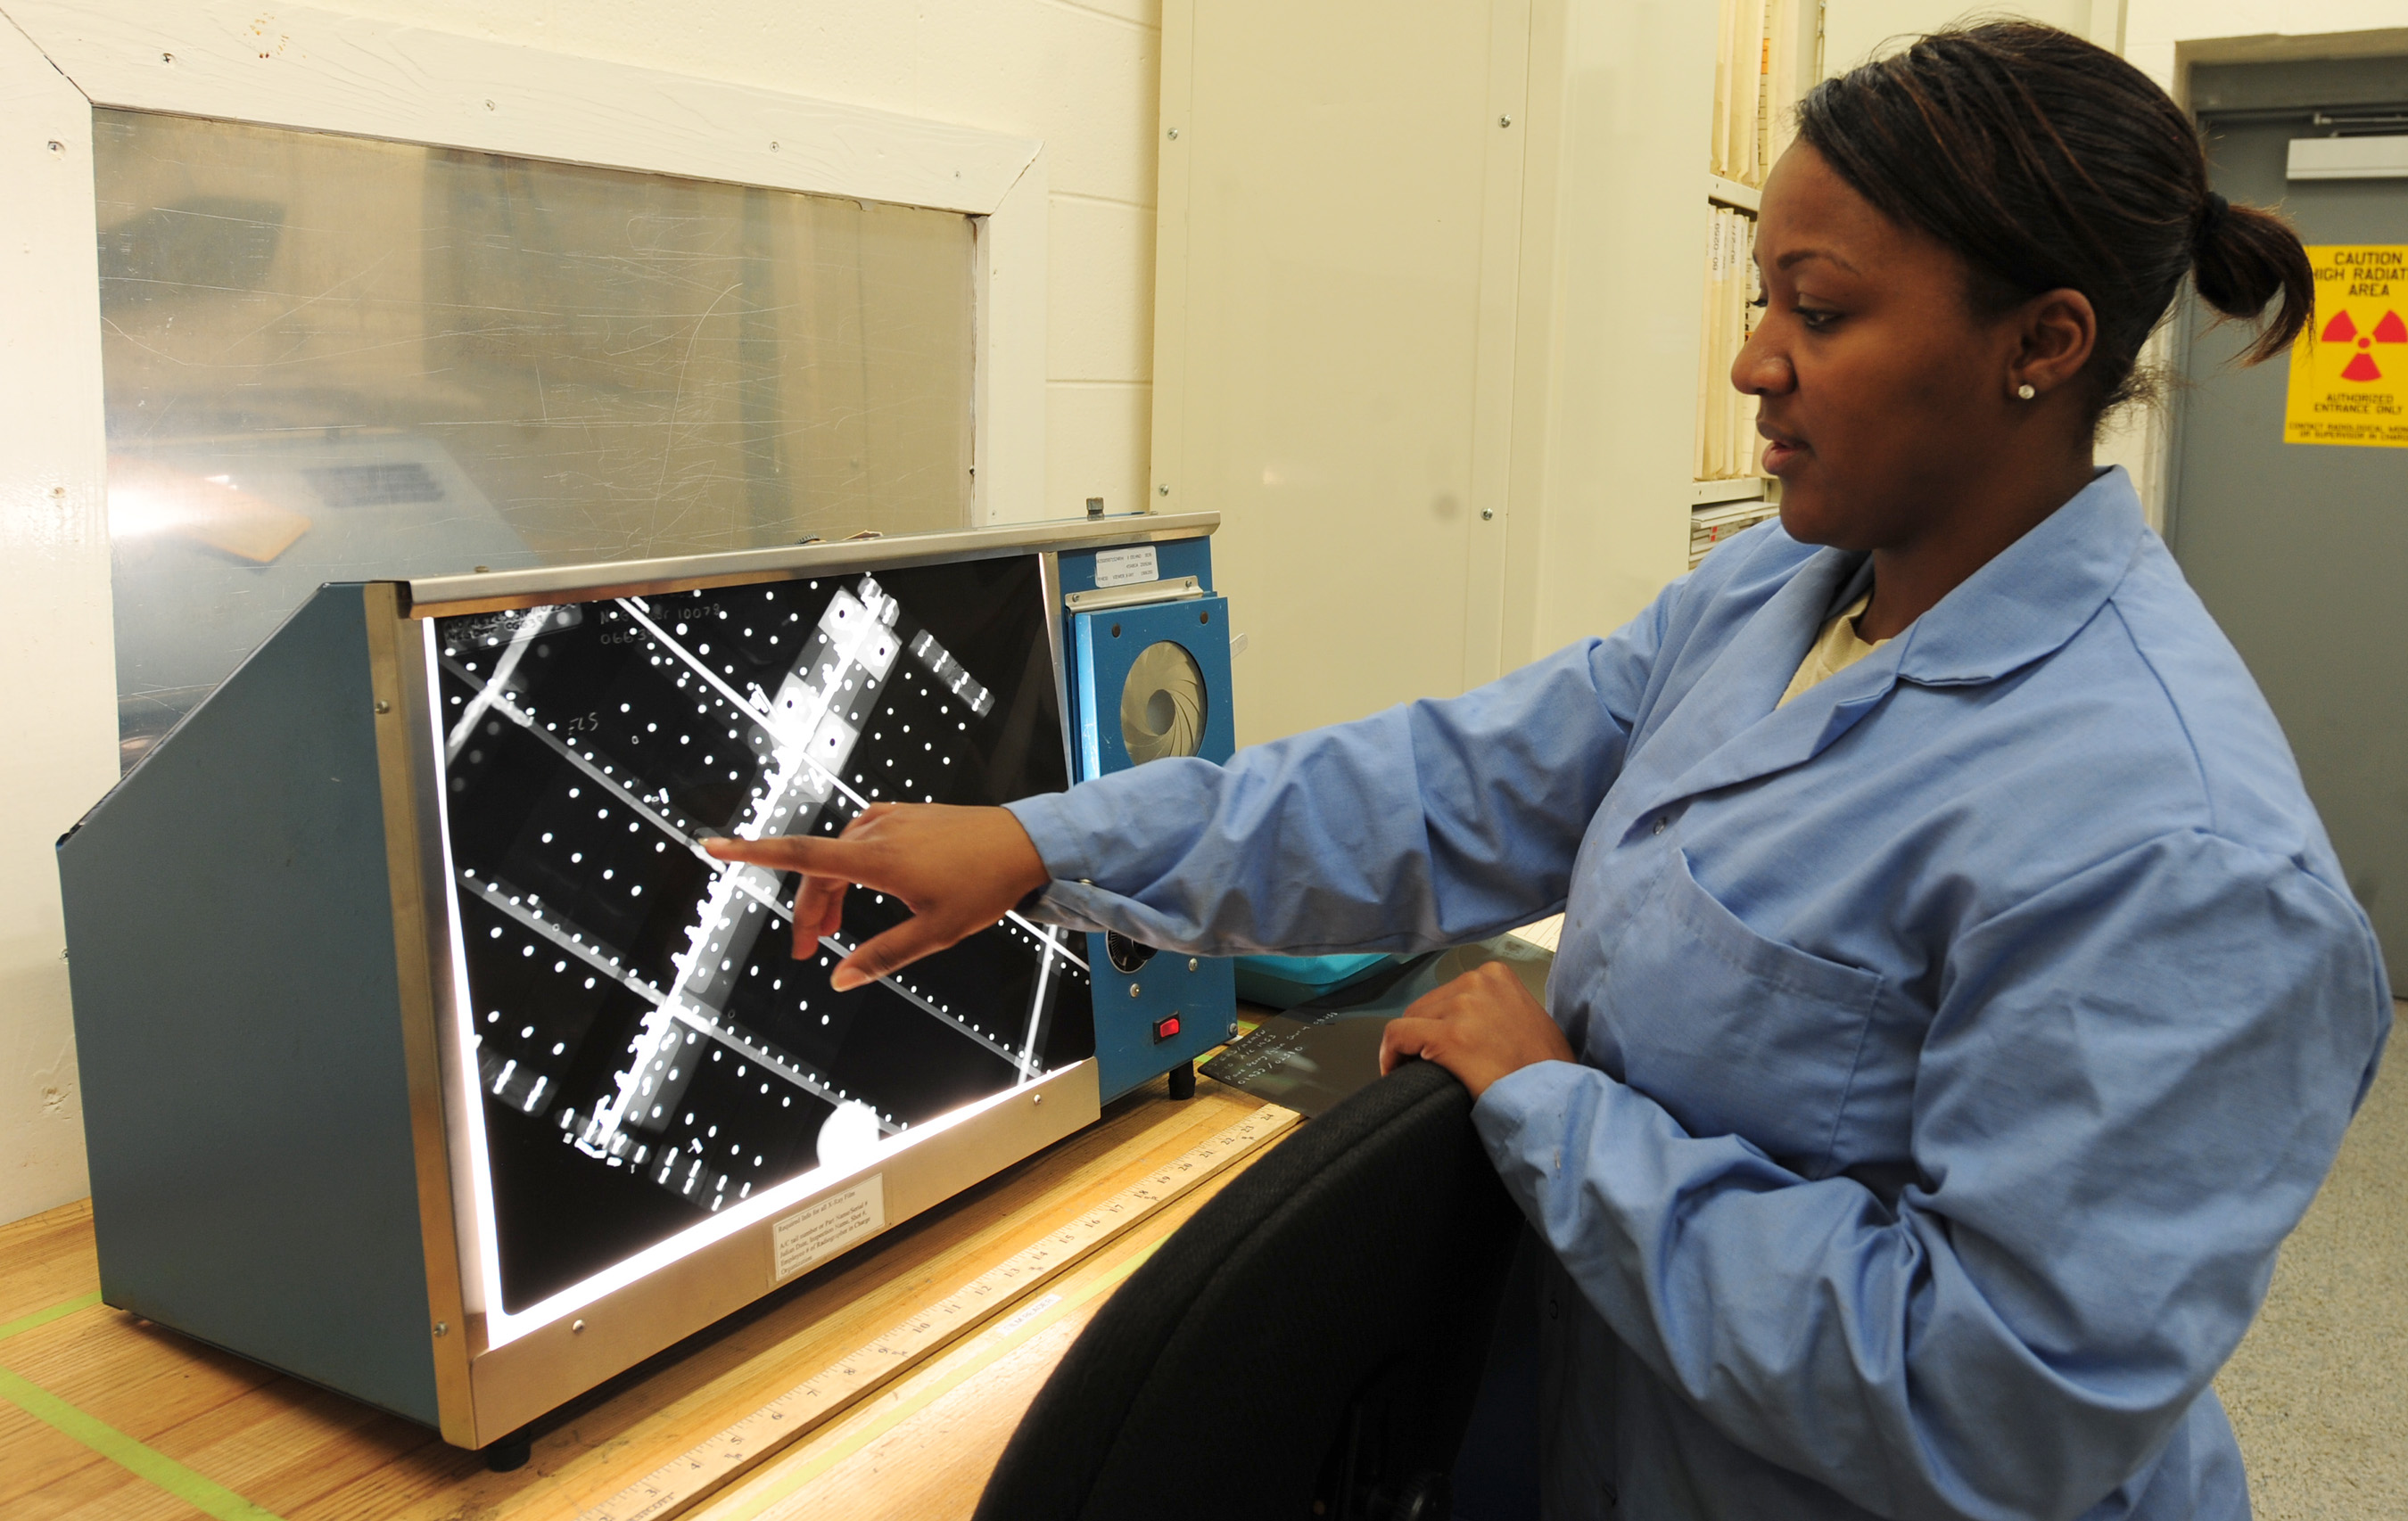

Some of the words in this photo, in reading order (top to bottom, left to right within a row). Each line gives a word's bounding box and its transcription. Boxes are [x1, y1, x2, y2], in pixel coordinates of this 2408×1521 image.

[2334, 251, 2403, 266] CAUTION
[2348, 283, 2390, 297] AREA
[2326, 393, 2394, 405] AUTHORIZED
[2313, 403, 2370, 414] ENTRANCE
[2376, 406, 2403, 415] ONLY
[1260, 1114, 1274, 1122] 24
[1241, 1125, 1254, 1134] 23
[1221, 1137, 1235, 1146] 22
[1199, 1150, 1214, 1159] 21
[1178, 1163, 1192, 1172] 20
[1157, 1175, 1171, 1185] 19
[1134, 1189, 1149, 1198] 18
[778, 1218, 801, 1232] Required
[828, 1198, 844, 1208] X-Ray
[844, 1191, 855, 1200] Film
[1109, 1204, 1124, 1213] 17
[1084, 1220, 1101, 1228] 16
[800, 1226, 818, 1239] number
[779, 1248, 796, 1259] Julian
[810, 1227, 834, 1243] Inspection
[780, 1250, 806, 1267] Employee
[816, 1228, 848, 1248] Radiographer
[854, 1217, 870, 1229] Charge
[1059, 1234, 1075, 1244] 15
[1032, 1251, 1048, 1260] 14
[1003, 1268, 1020, 1278] 13
[975, 1286, 993, 1295] 12
[944, 1303, 961, 1314] 11
[911, 1322, 931, 1334] 10
[844, 1368, 855, 1376] 8
[771, 1411, 783, 1420] 6
[730, 1436, 742, 1445] 5
[690, 1462, 701, 1470] 4
[645, 1489, 658, 1497] 3
